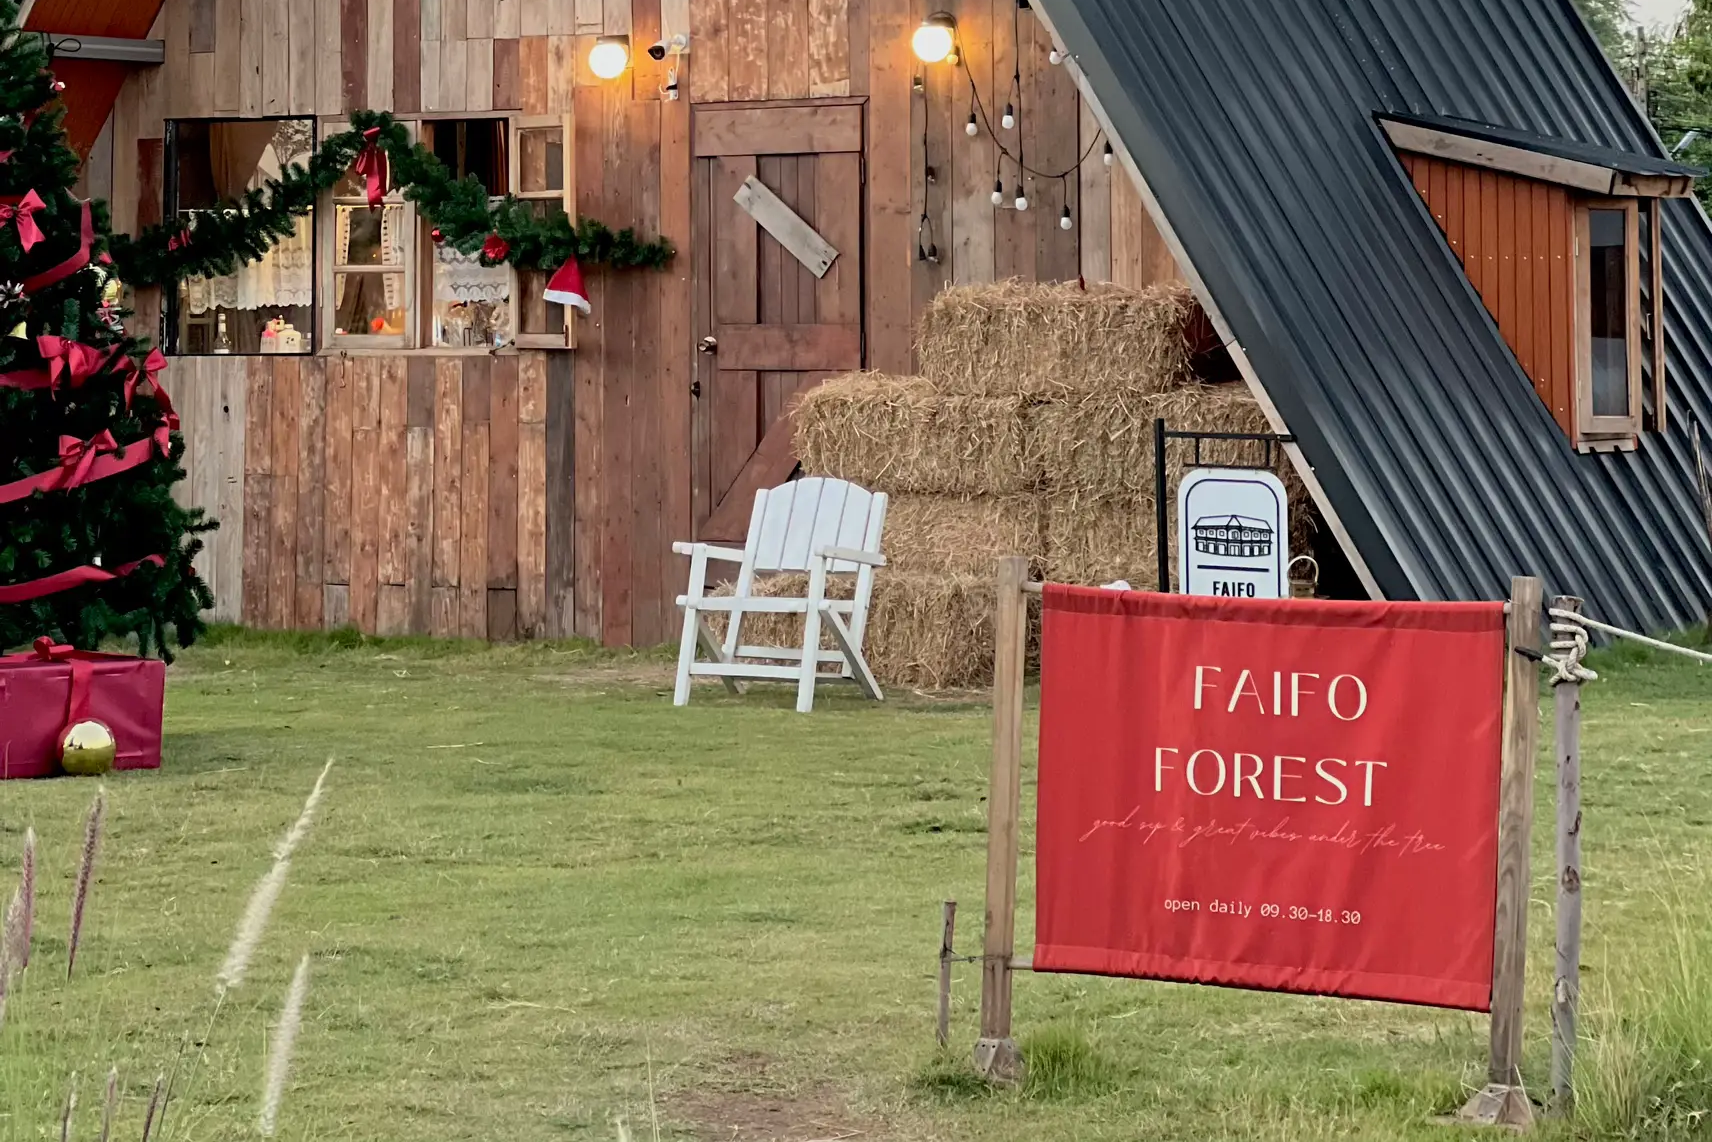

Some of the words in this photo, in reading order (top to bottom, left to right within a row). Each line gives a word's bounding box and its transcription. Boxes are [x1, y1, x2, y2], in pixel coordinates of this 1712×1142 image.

[1213, 581, 1255, 597] FAIFO
[1194, 665, 1367, 721] FAIFO
[1155, 747, 1388, 807] FOREST
[1078, 805, 1140, 842] good
[1170, 816, 1185, 833] &
[1178, 817, 1256, 848] great
[1250, 816, 1302, 842] vibes
[1308, 820, 1362, 849] under
[1360, 822, 1400, 856] the
[1398, 829, 1446, 859] tree
[1164, 899, 1200, 913] open
[1209, 899, 1252, 919] daily
[1260, 903, 1361, 925] 09.30-18.30
